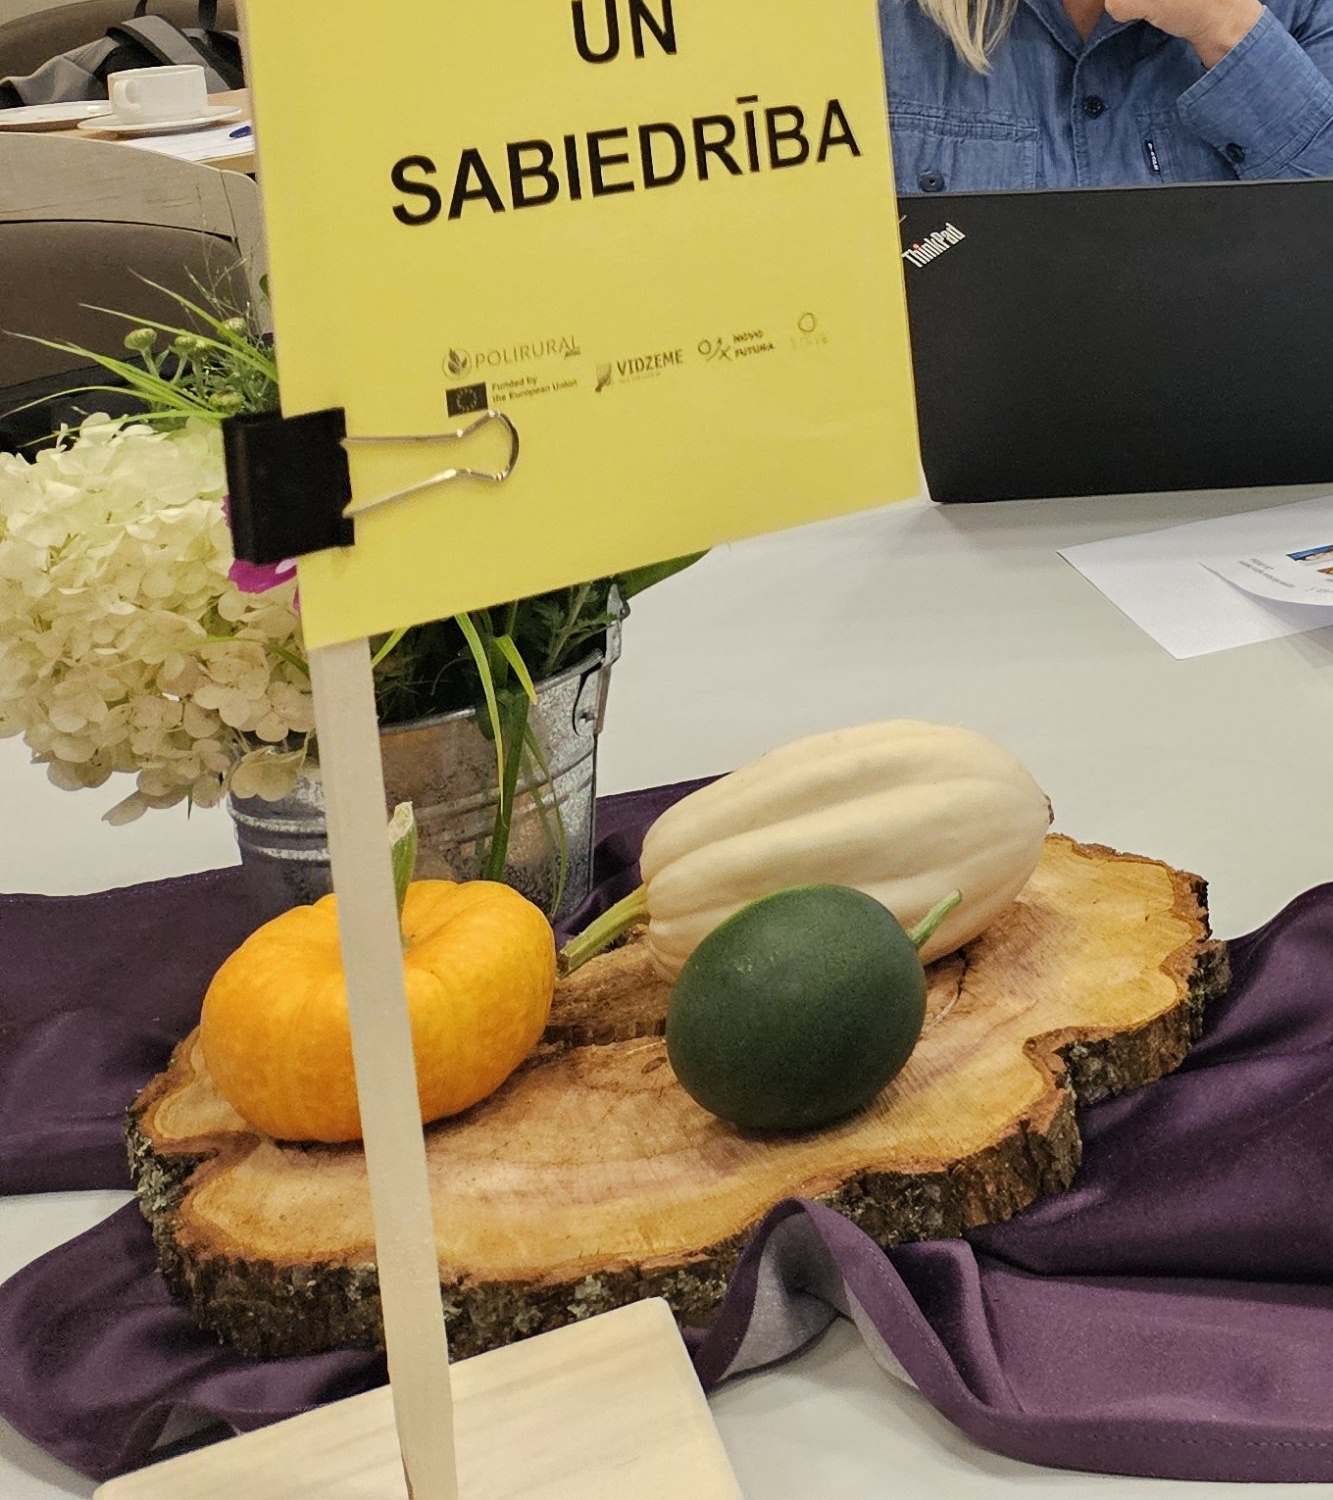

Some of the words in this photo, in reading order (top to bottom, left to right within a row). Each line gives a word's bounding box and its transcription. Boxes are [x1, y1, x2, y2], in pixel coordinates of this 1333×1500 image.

[390, 94, 861, 226] SABIEDRĪBA
[901, 222, 966, 268] ThinkPad
[475, 335, 578, 369] POLIRURAL
[617, 349, 684, 377] VIDZEME
[492, 377, 525, 391] Funded
[526, 375, 538, 386] by
[509, 385, 551, 401] European
[553, 379, 578, 392] Union
